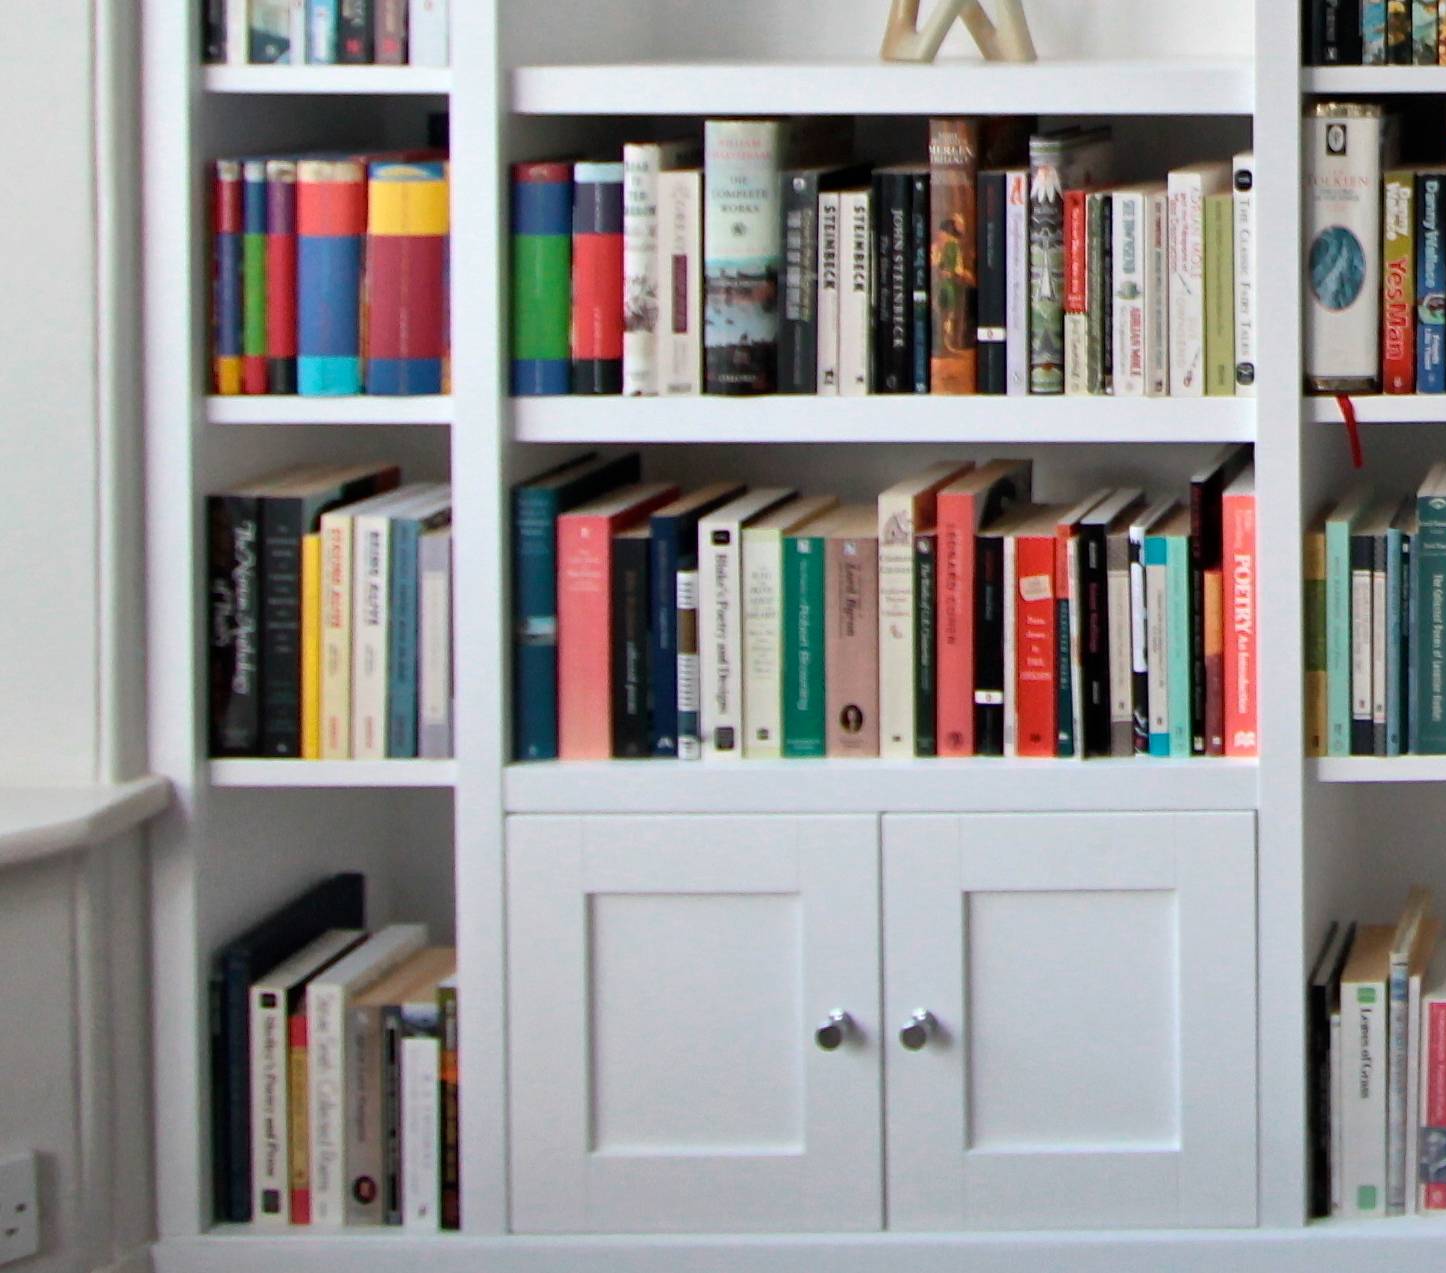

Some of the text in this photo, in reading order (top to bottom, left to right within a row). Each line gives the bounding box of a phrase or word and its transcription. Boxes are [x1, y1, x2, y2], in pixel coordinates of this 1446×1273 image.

[822, 205, 836, 291] STEINBECK
[852, 205, 867, 293] STEINBECK
[1385, 182, 1399, 242] Wallace
[1397, 186, 1411, 237] Danny
[1422, 180, 1439, 289] Danny Wallace
[890, 208, 905, 348] JOHN STEINBECK
[1384, 257, 1410, 362] Yes Man
[946, 524, 957, 646] LEONARD COHEN
[1233, 554, 1253, 633] POETRY
[1432, 574, 1444, 588] The
[1432, 589, 1444, 623] Collected
[715, 553, 730, 715] Blake's Poetry and Designs
[1432, 625, 1444, 649] Poems
[1360, 1008, 1373, 1099] Leaves of Grass
[264, 1117, 277, 1139] and
